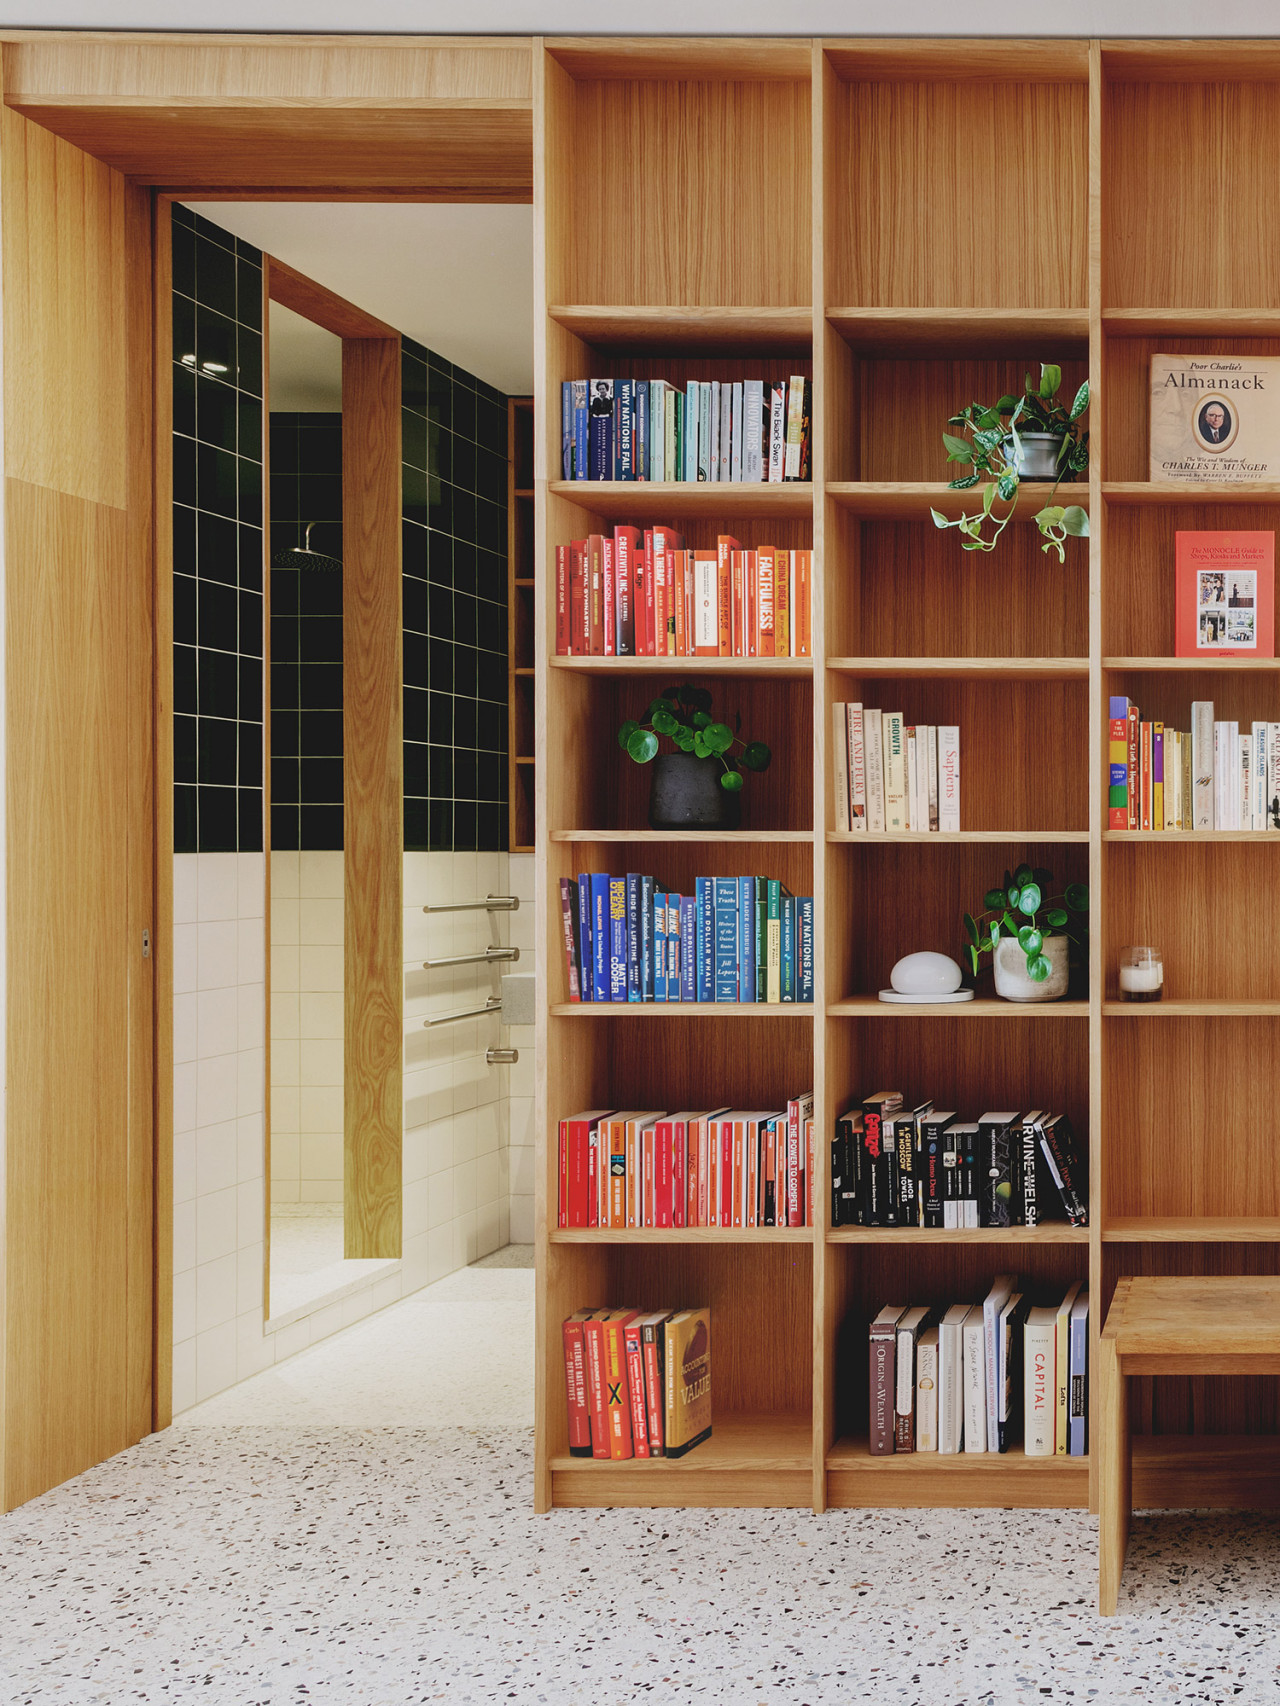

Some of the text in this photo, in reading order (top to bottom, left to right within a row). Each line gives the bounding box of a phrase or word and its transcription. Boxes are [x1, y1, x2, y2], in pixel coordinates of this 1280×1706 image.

[1164, 373, 1265, 390] Almanack
[1210, 363, 1242, 372] Charlie's
[622, 384, 630, 471] WHY NATIONS FAIL
[746, 391, 759, 450] INNOVATORS
[772, 402, 782, 466] The Black Swan
[1162, 462, 1268, 471] CHARLES T. MUNGER
[619, 536, 628, 594] CREATIVITY, INC.
[636, 564, 644, 589] nudge
[760, 557, 773, 629] FACTFULNESS
[778, 560, 786, 610] CHINA DREAM
[853, 710, 864, 796] FIRE AND FURY
[892, 718, 900, 755] GROWTH
[943, 750, 957, 798] Sapiens
[631, 912, 636, 922] OF
[790, 1167, 798, 1176] TO
[1022, 1120, 1036, 1226] IRVINE WELSH
[574, 1342, 582, 1369] INTEREST
[876, 1348, 886, 1381] ORIGIN
[680, 1375, 710, 1405] VALUE
[1035, 1353, 1045, 1410] CAPITAL
[876, 1391, 886, 1429] WEALTH
